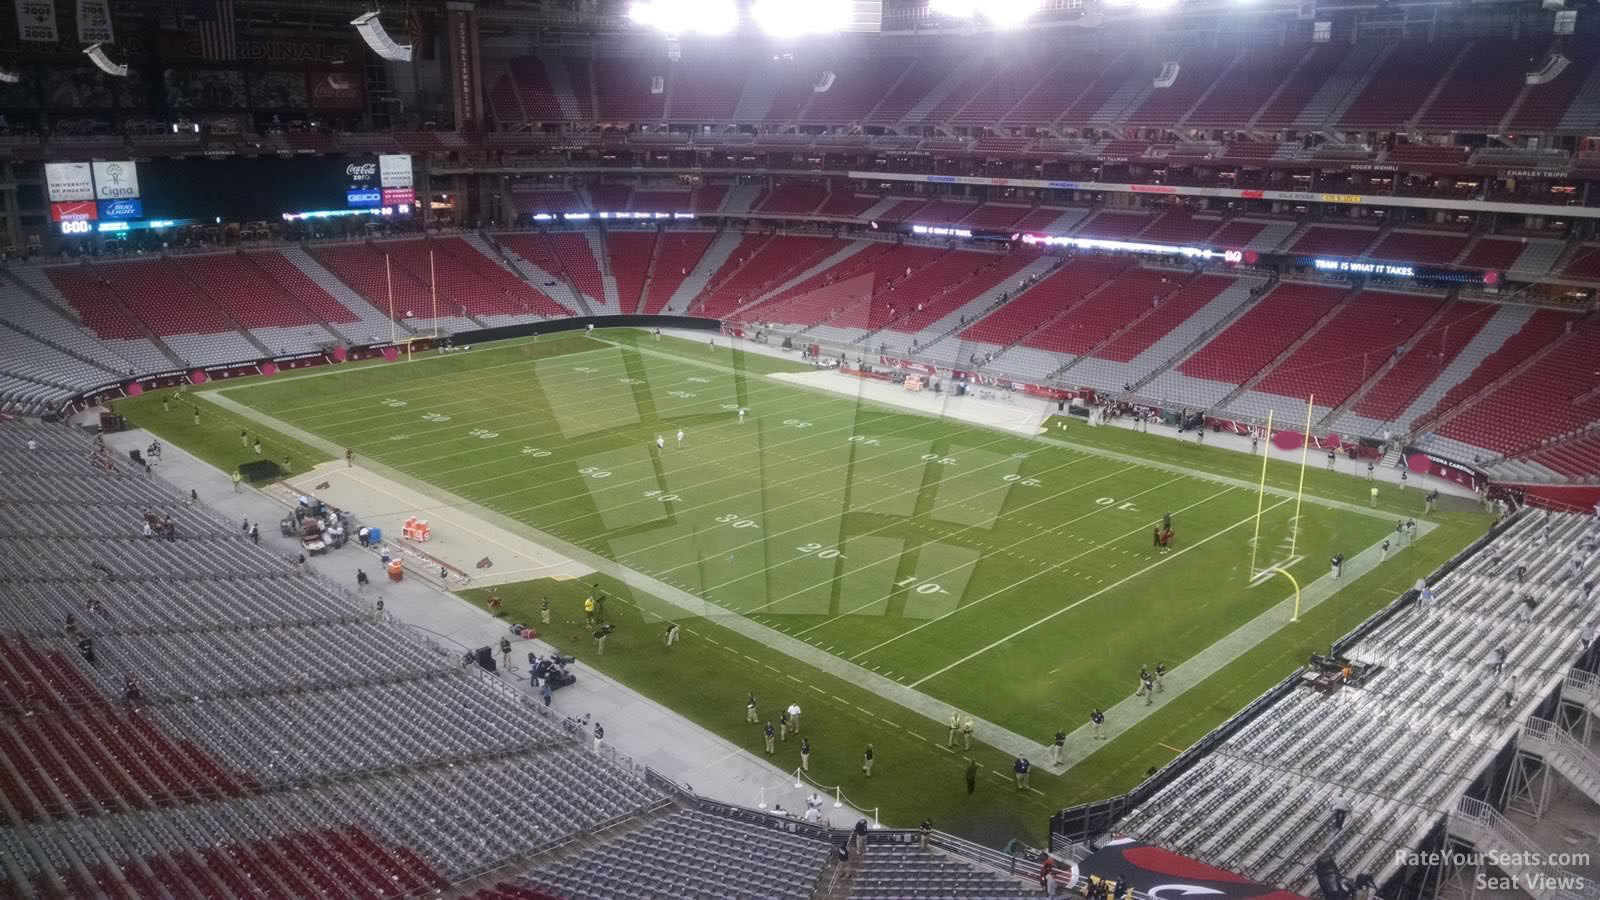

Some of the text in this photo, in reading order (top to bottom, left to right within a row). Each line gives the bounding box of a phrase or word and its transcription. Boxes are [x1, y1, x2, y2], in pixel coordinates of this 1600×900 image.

[101, 186, 133, 197] Cigna
[1341, 262, 1349, 270] IS
[1350, 263, 1375, 272] WHAT
[1376, 265, 1384, 273] IT
[1386, 266, 1415, 276] TAKES.
[578, 466, 612, 479] 50
[643, 490, 678, 502] 40
[715, 513, 754, 528] 30
[796, 542, 841, 559] 20
[895, 575, 940, 594] 10
